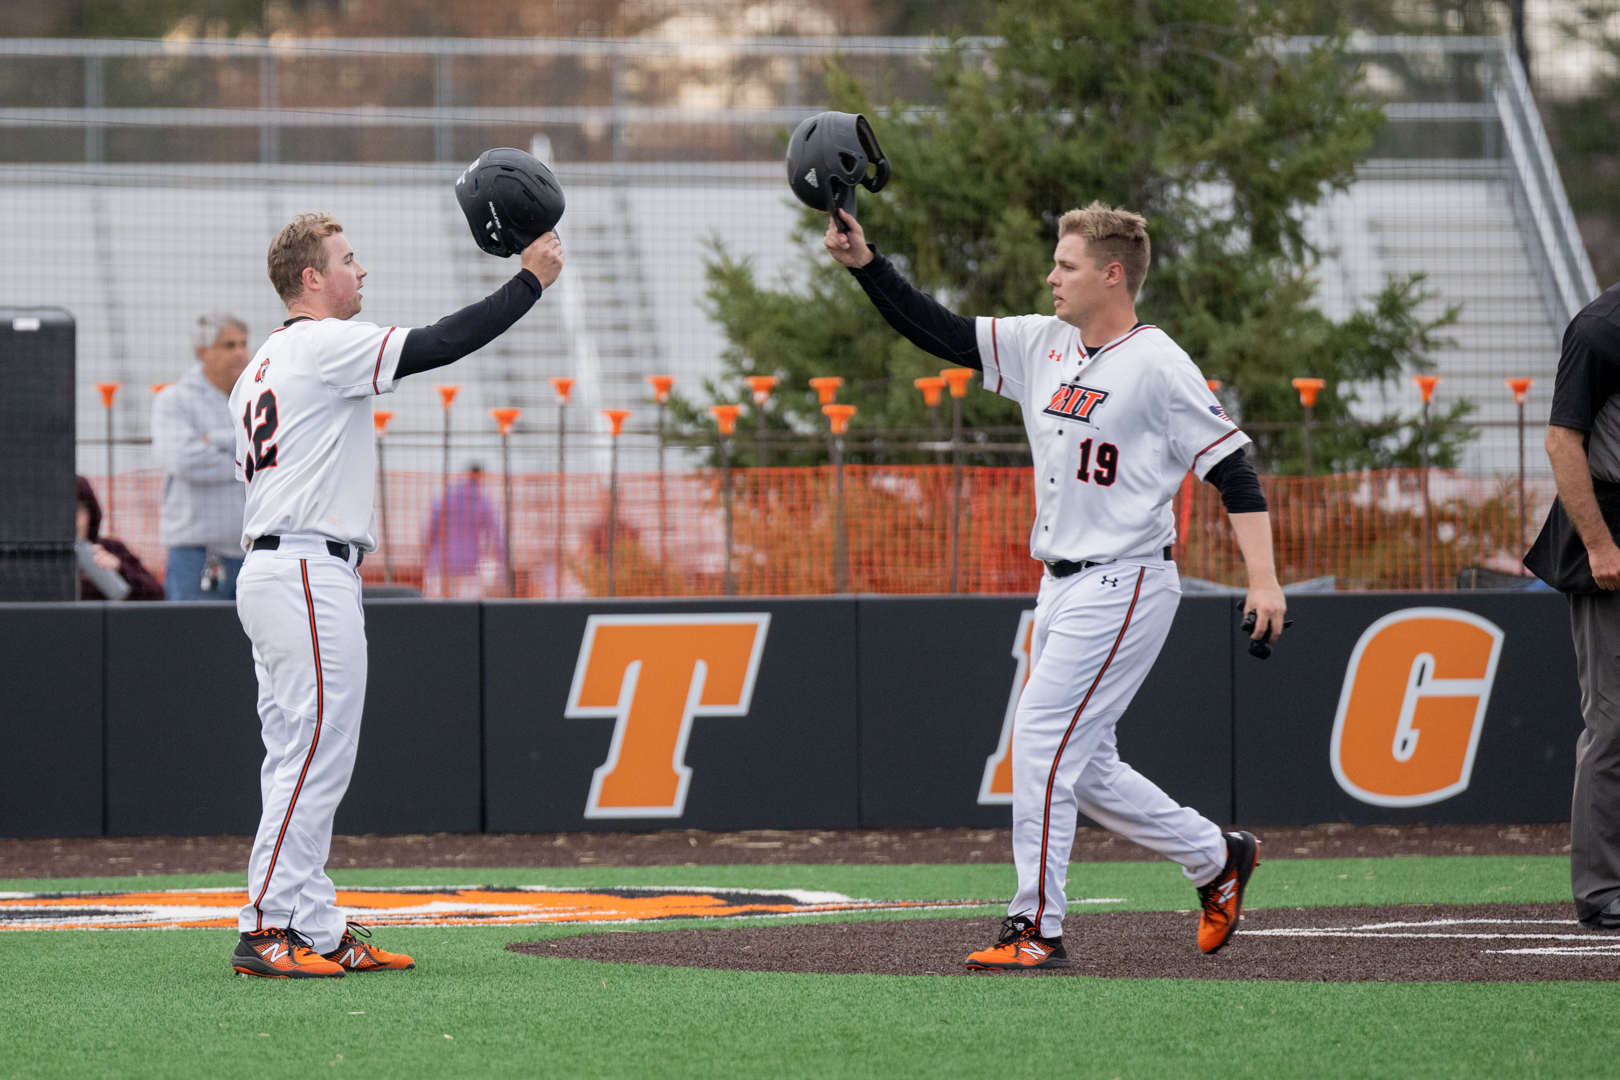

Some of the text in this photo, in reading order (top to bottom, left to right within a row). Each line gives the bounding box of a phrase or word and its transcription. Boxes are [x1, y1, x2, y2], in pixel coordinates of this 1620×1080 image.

[1042, 382, 1109, 423] RIT
[242, 388, 278, 484] 12
[1076, 437, 1119, 487] 19
